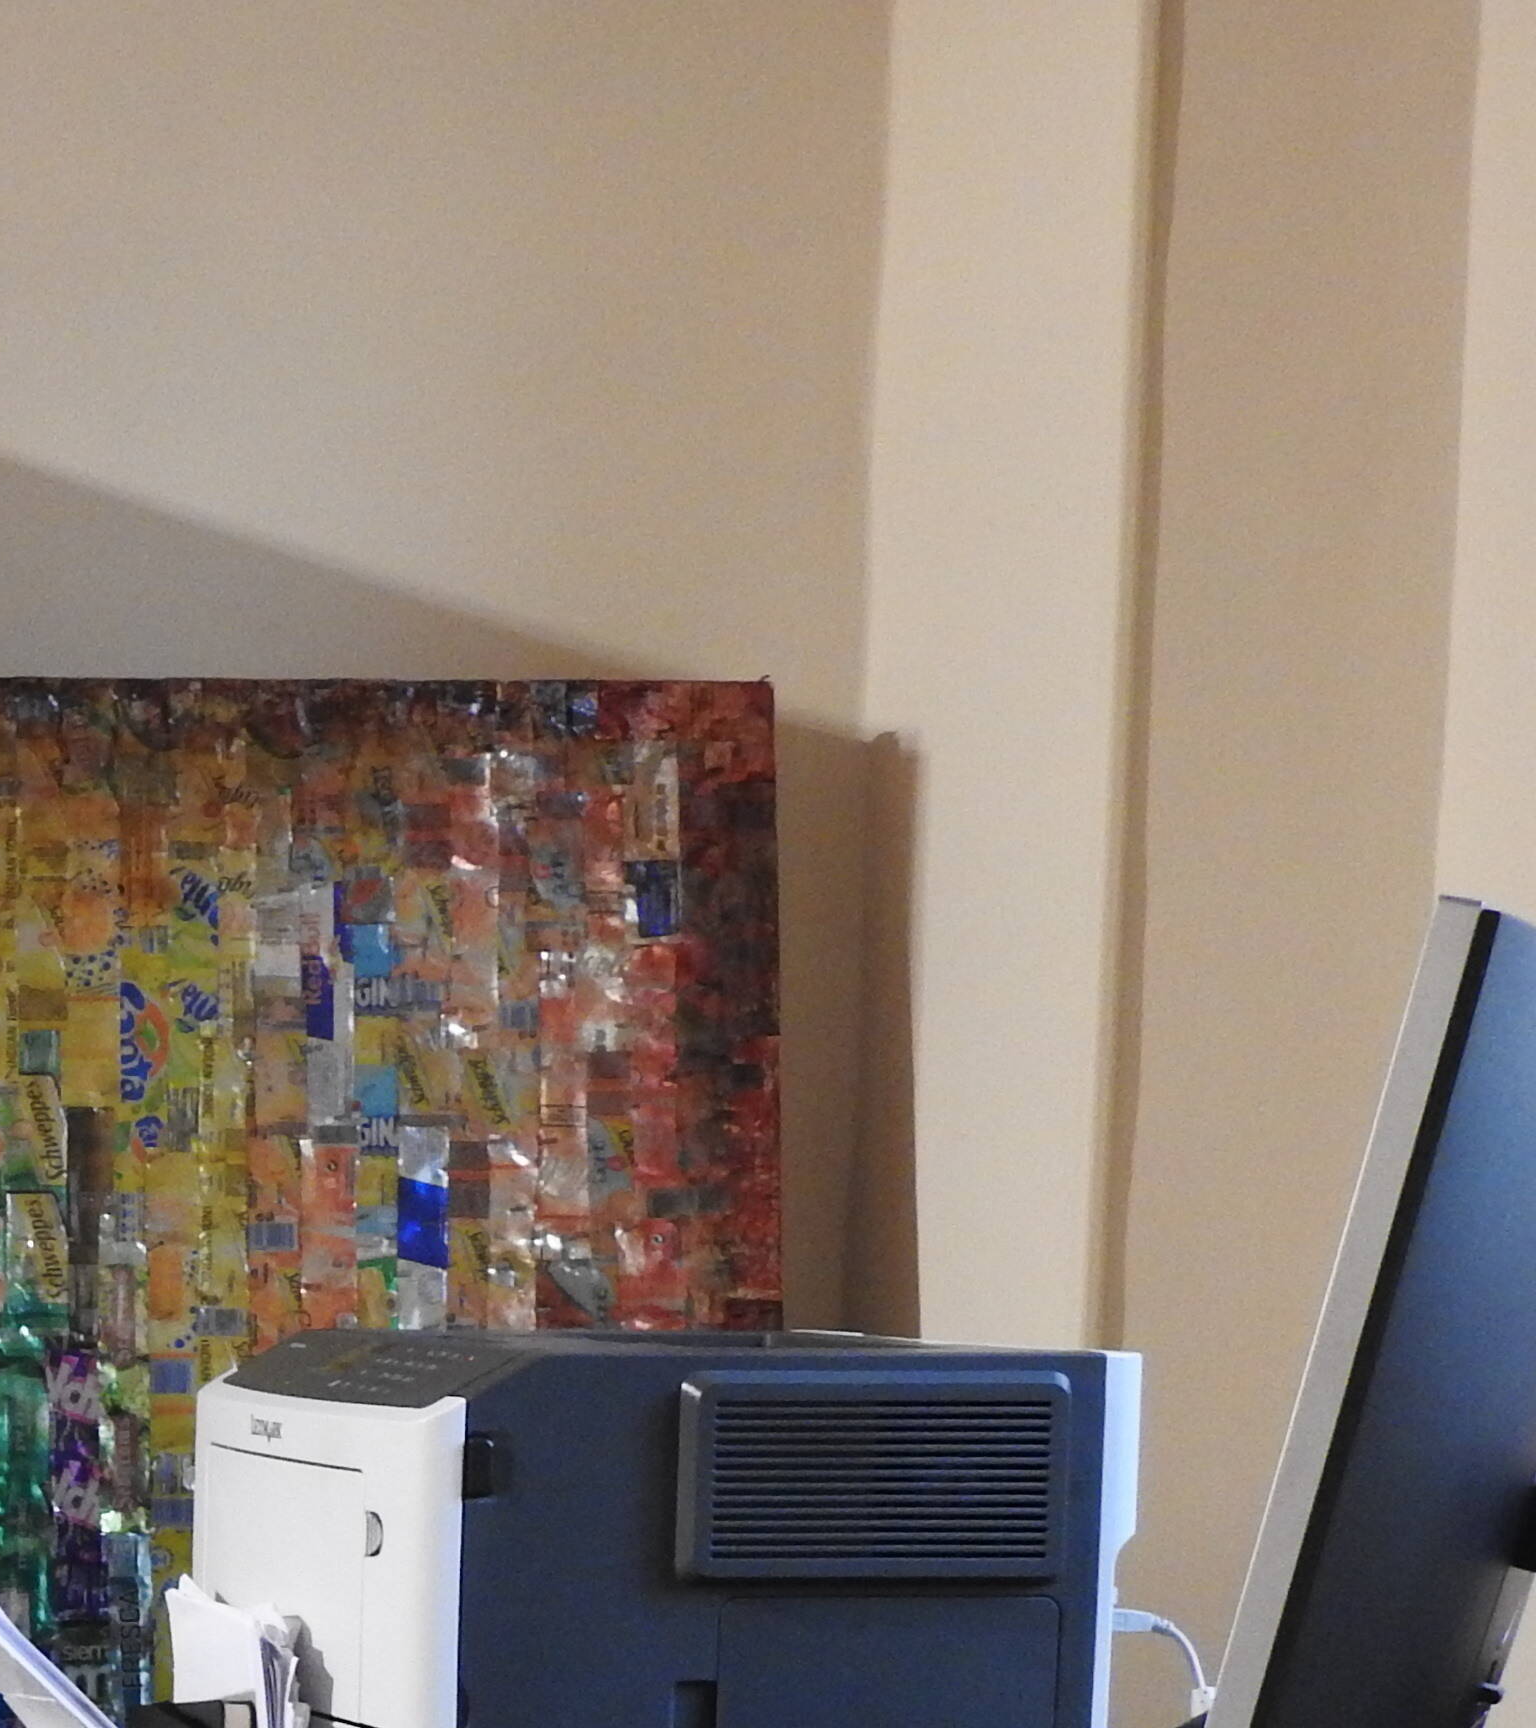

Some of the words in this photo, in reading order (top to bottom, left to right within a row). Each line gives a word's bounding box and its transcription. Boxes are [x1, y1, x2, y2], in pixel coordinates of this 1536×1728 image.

[24, 1079, 67, 1182] Schweppes
[26, 1198, 68, 1300] Schweppes
[119, 1587, 142, 1690] FRESCA
